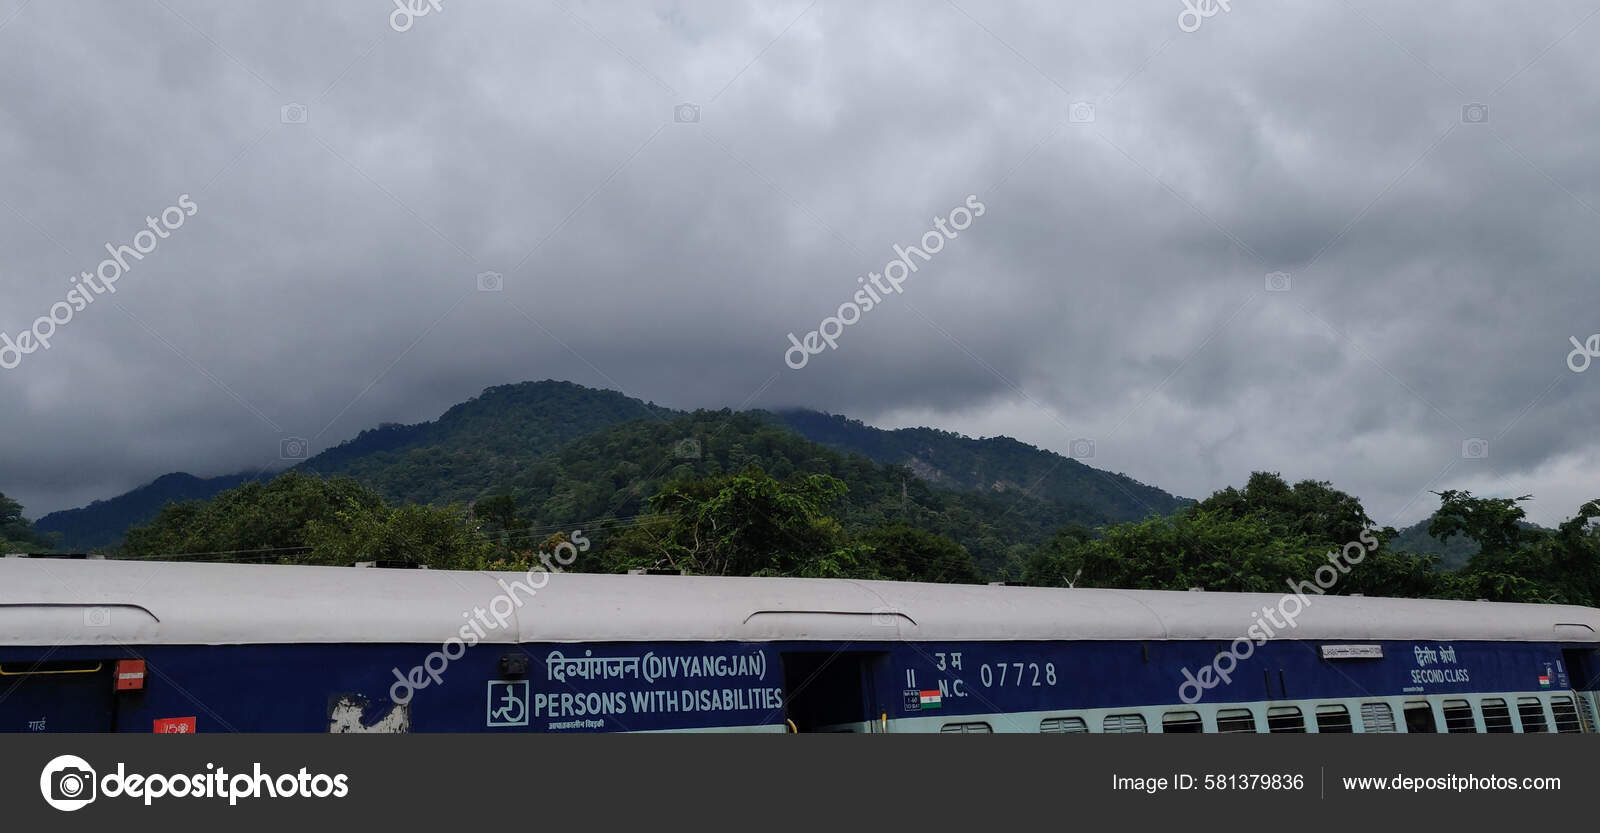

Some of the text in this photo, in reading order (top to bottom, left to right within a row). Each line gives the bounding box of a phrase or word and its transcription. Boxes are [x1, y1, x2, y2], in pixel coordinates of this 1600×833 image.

[642, 649, 767, 684] (DIVYANGJAN)
[980, 662, 1057, 688] 07728
[1410, 668, 1470, 684] SECOND CLASS
[534, 687, 783, 718] PERSONS WITH DISABILITIES
